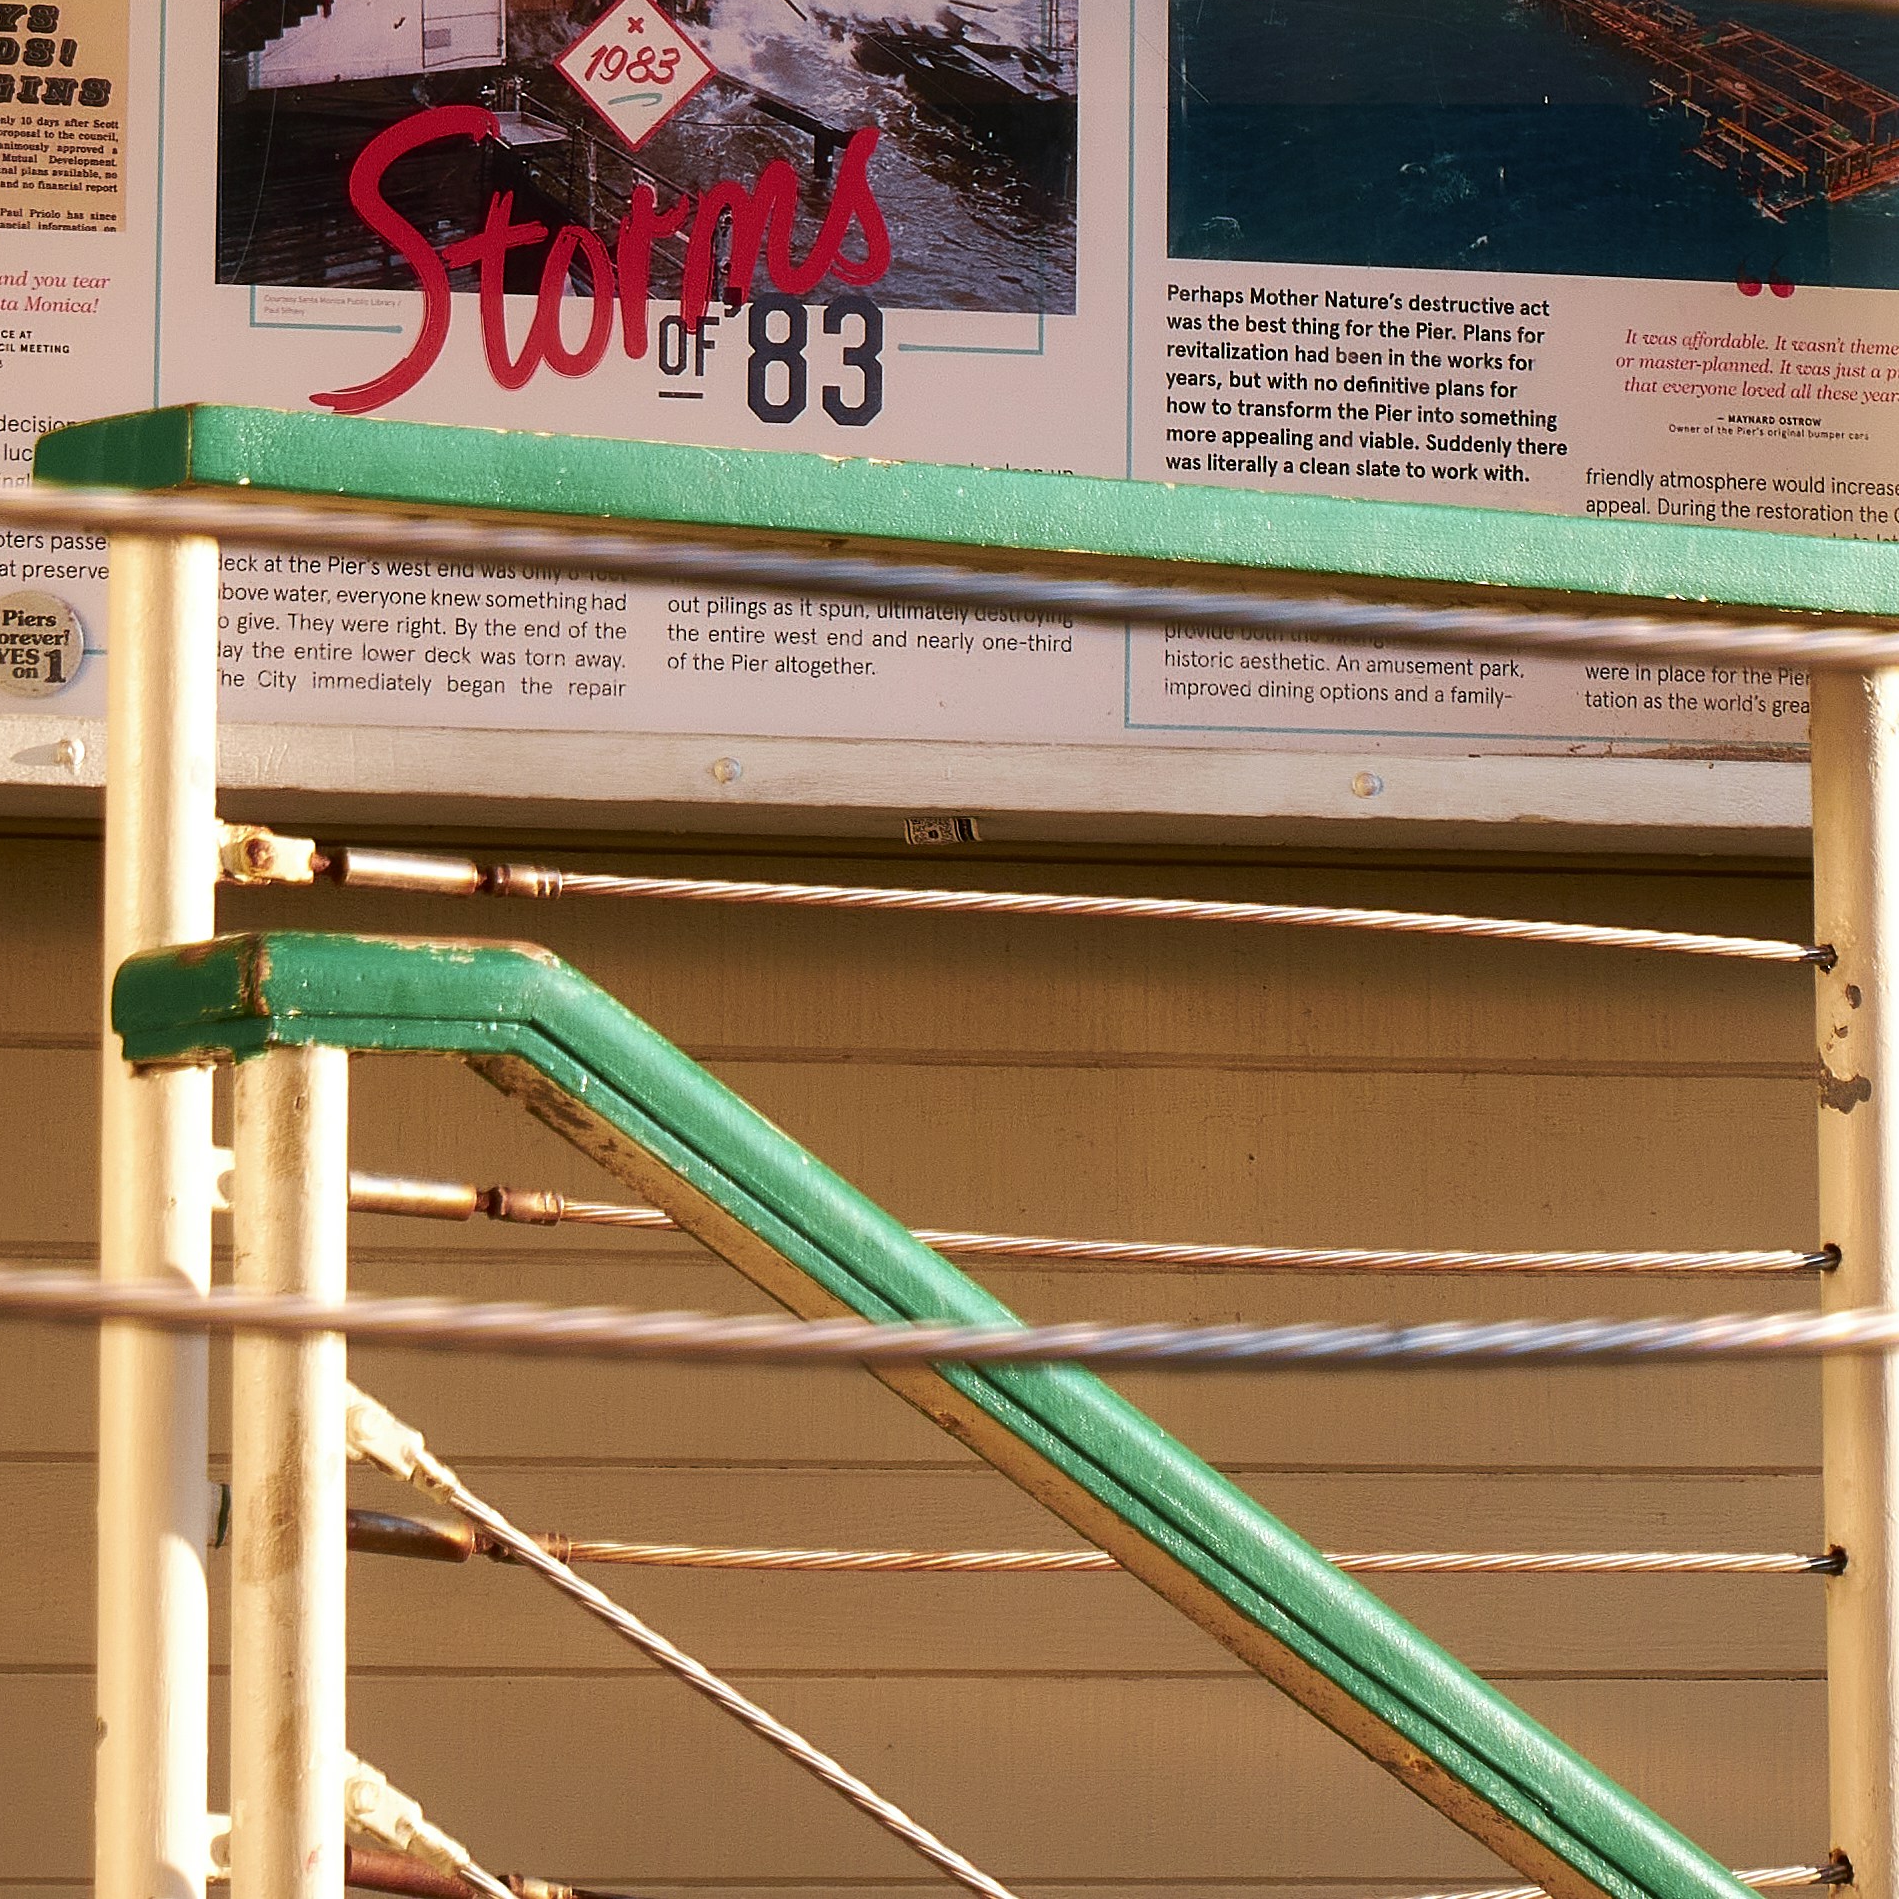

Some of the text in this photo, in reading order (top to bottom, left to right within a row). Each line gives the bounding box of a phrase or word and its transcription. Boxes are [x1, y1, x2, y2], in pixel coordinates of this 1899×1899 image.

[584, 44, 681, 86] 1983
[20, 116, 33, 126] 10
[35, 116, 60, 128] days
[63, 117, 90, 128] after
[92, 118, 120, 130] Scott
[309, 105, 892, 414] Storms
[30, 275, 67, 291] you
[72, 275, 111, 289] tear
[23, 295, 100, 314] Monica!
[1167, 283, 1551, 318] Perhaps Mother Nature's destructive act
[18, 329, 33, 340] AT
[1165, 312, 1546, 345] was the best thing for the Pier. Plans for
[19, 343, 70, 355] MEETING
[1624, 328, 1638, 345] It
[1641, 333, 1678, 347] was
[1681, 330, 1769, 352] affordable.
[1773, 334, 1788, 352] It
[1790, 336, 1846, 354] wasn't
[658, 287, 884, 427] OF '83
[1727, 413, 1822, 427] MAYNARD OSTROW
[1668, 423, 1869, 441] Owner of the Pier's original bumper cars
[2, 609, 57, 627] Piers
[666, 622, 1073, 655] the entire west end and nearly one-third
[12, 665, 40, 680] on
[43, 649, 67, 684] 1
[666, 651, 877, 680] of the Pier altogether.
